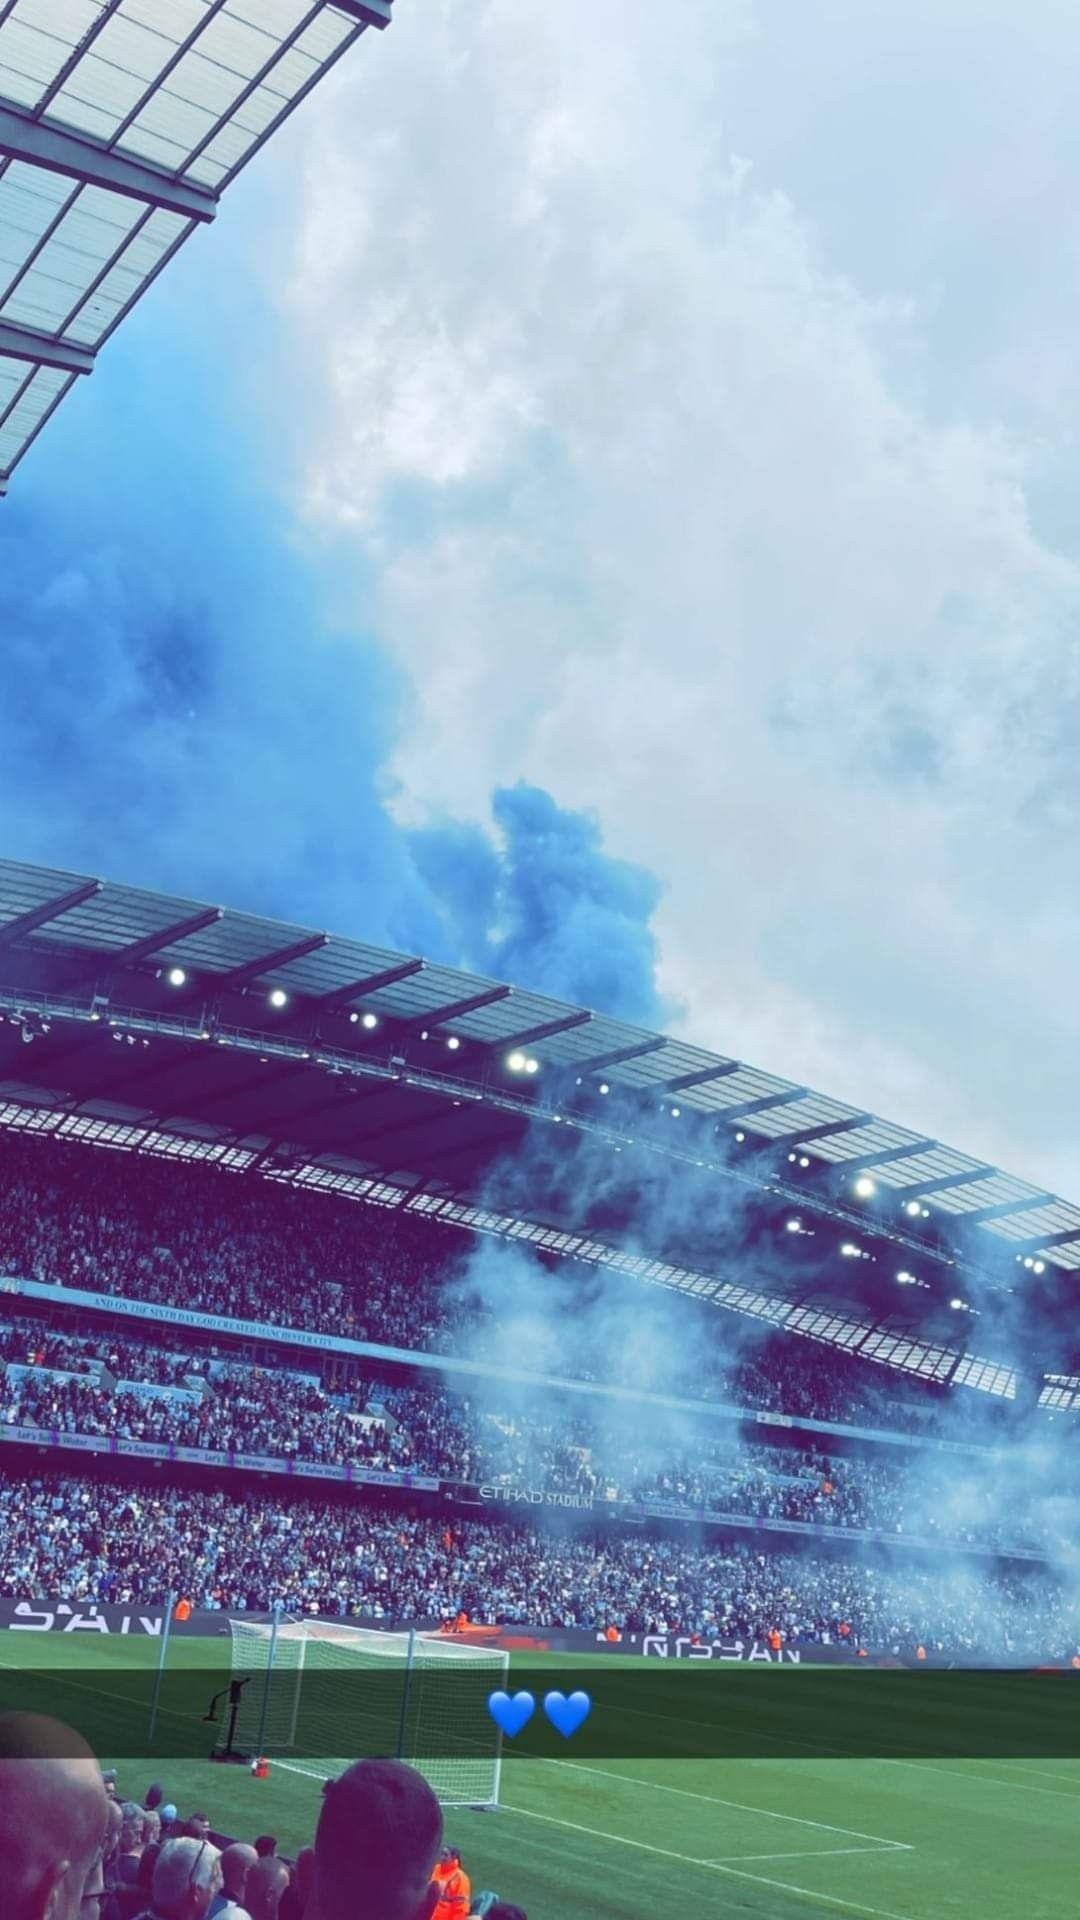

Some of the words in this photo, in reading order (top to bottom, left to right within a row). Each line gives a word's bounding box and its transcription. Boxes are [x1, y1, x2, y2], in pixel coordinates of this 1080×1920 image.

[130, 1304, 146, 1313] THE
[479, 1485, 543, 1504] ETIHAD
[546, 1493, 593, 1510] STADIUM
